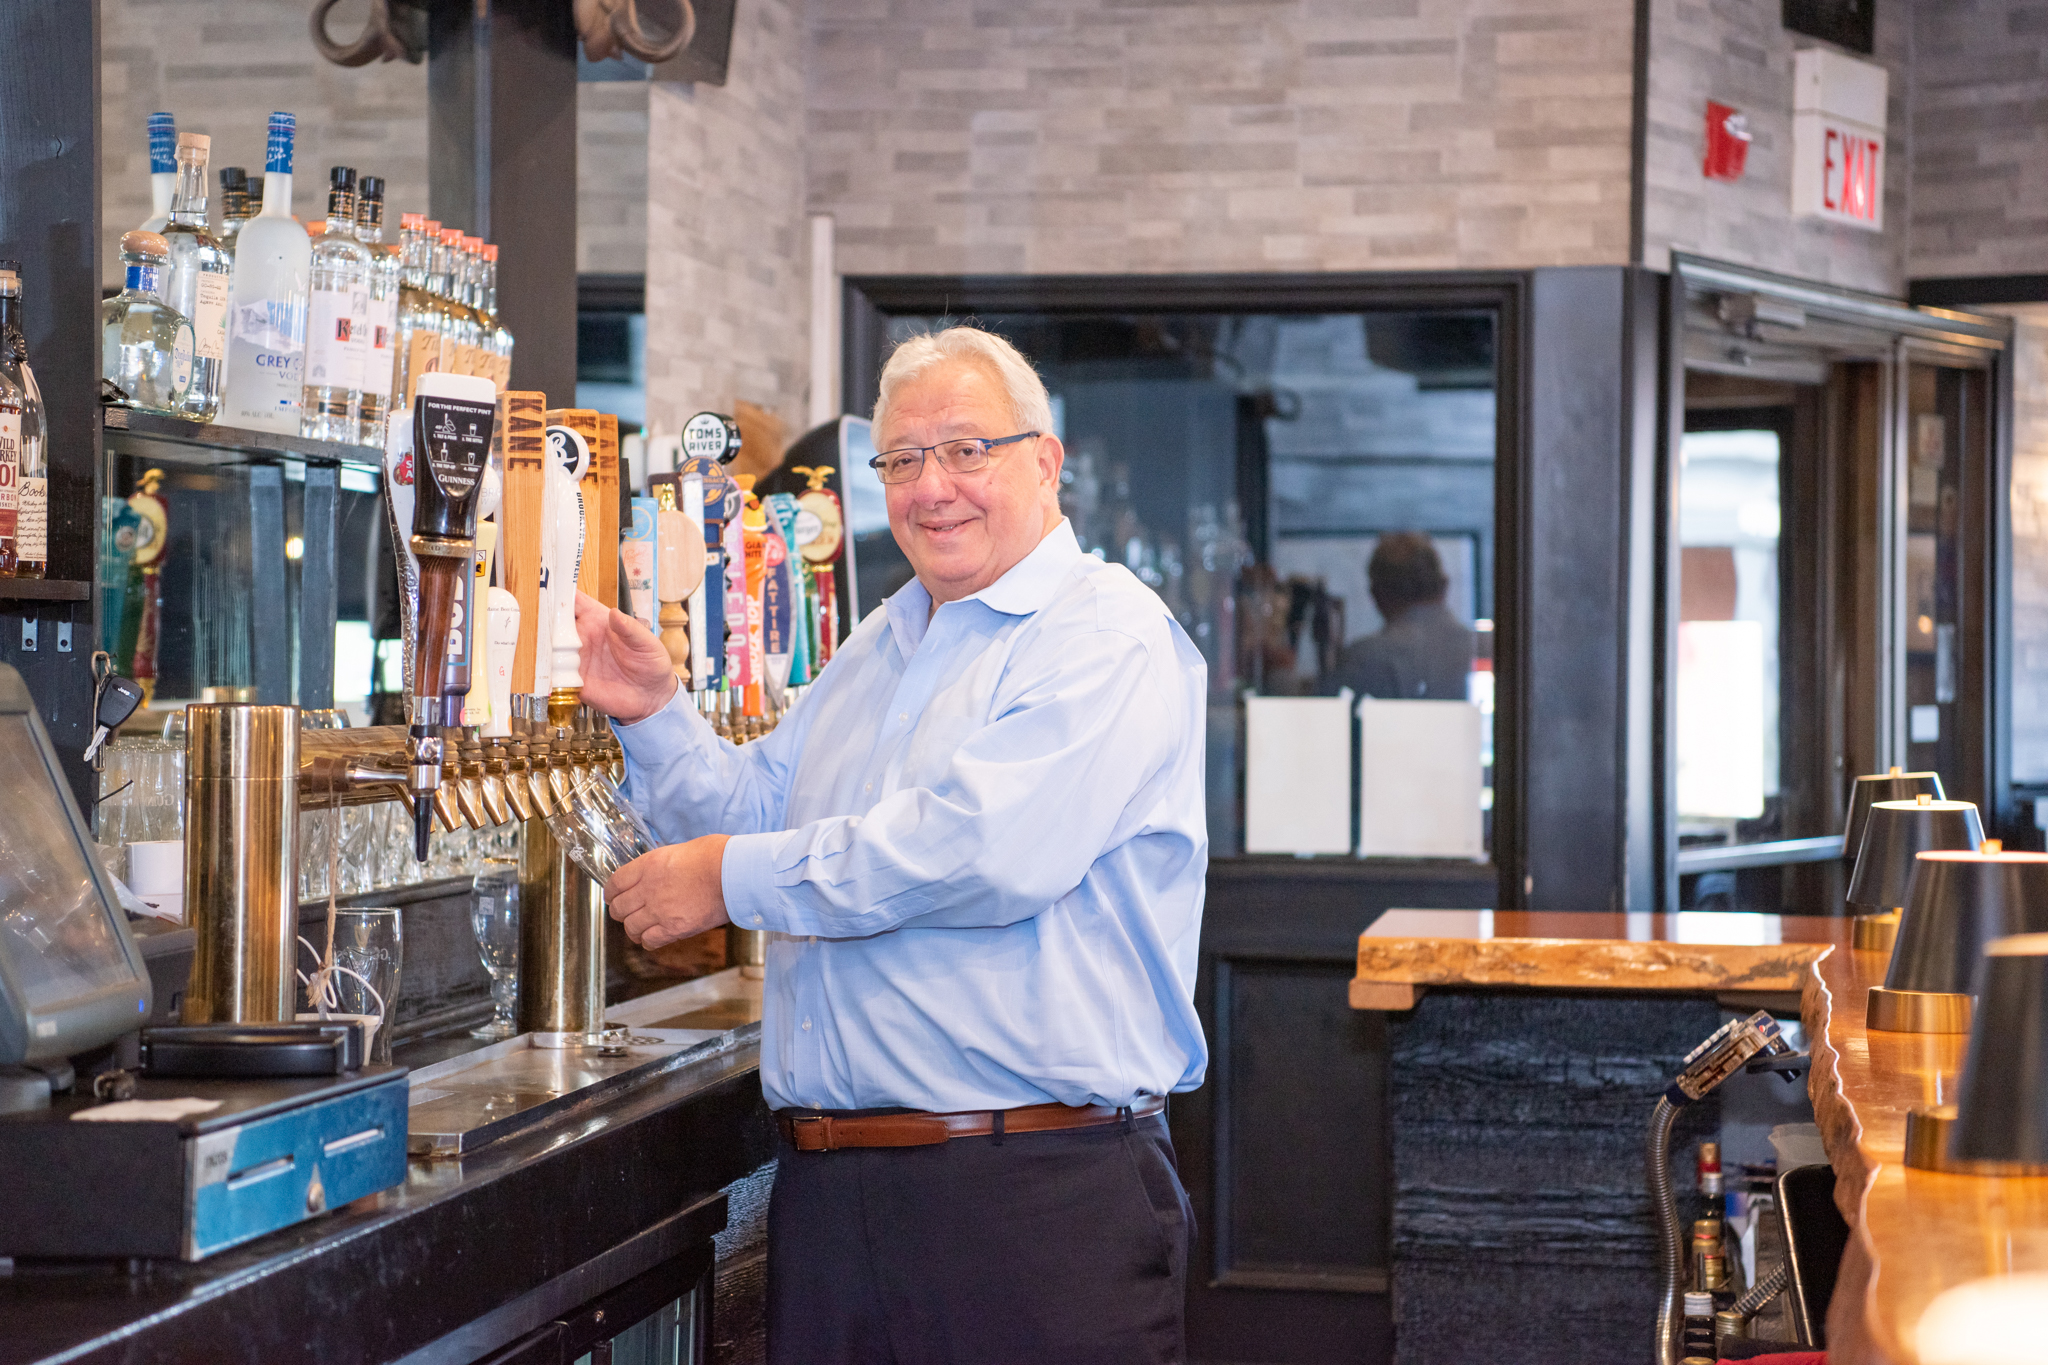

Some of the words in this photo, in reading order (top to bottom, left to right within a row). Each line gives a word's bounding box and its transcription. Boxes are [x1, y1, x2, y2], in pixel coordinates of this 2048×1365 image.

[1823, 128, 1879, 220] EXIT
[256, 354, 290, 369] GREY
[453, 405, 477, 414] PERFECT
[508, 398, 543, 471] KANE
[689, 428, 722, 439] TOMS
[689, 441, 722, 451] RIVER
[0, 450, 17, 464] RKEY
[0, 464, 16, 488] 01
[766, 568, 779, 603] FAT
[769, 606, 781, 654] TIRE
[117, 686, 130, 696] Jeep
